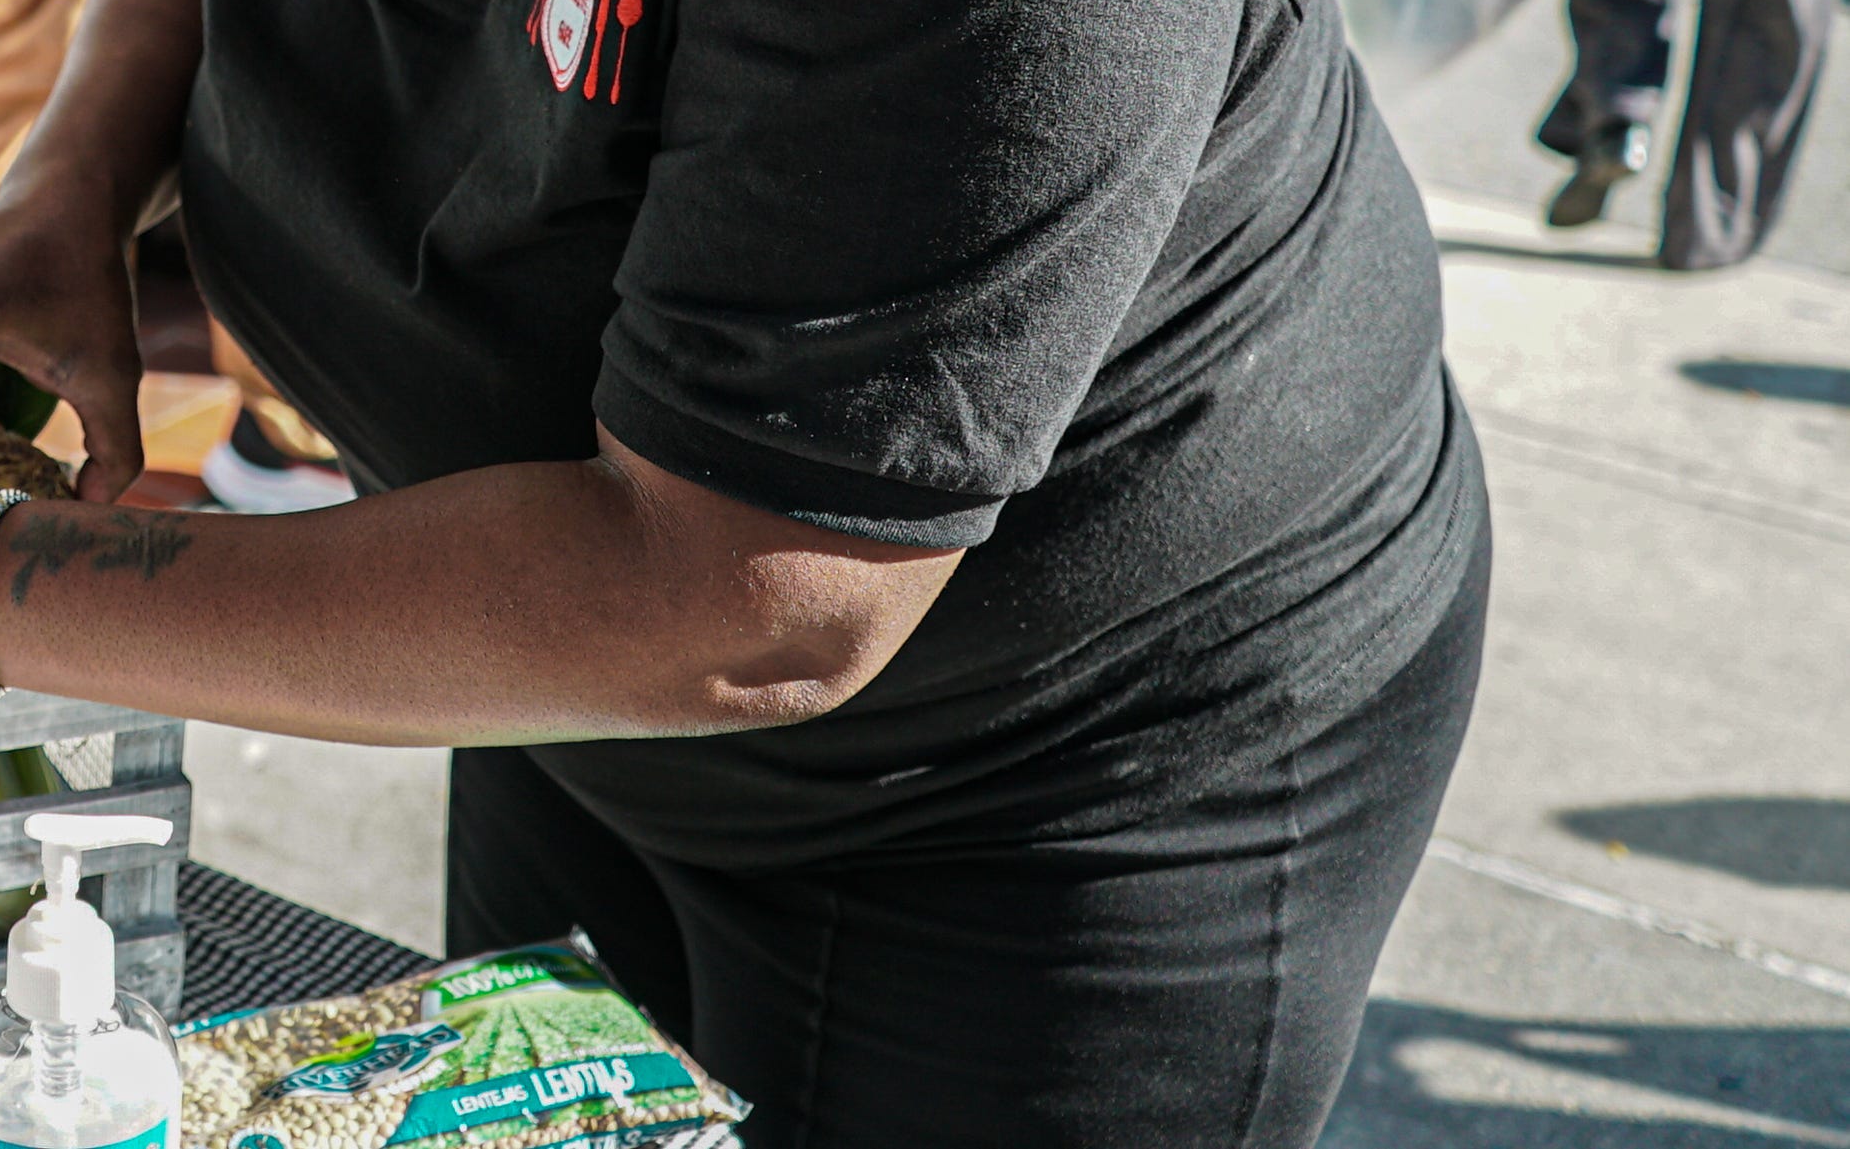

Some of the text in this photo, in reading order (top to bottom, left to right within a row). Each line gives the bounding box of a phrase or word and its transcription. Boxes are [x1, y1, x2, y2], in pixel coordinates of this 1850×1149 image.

[439, 962, 516, 999] 100%
[451, 1057, 635, 1116] LENTEJAS LENTILS
